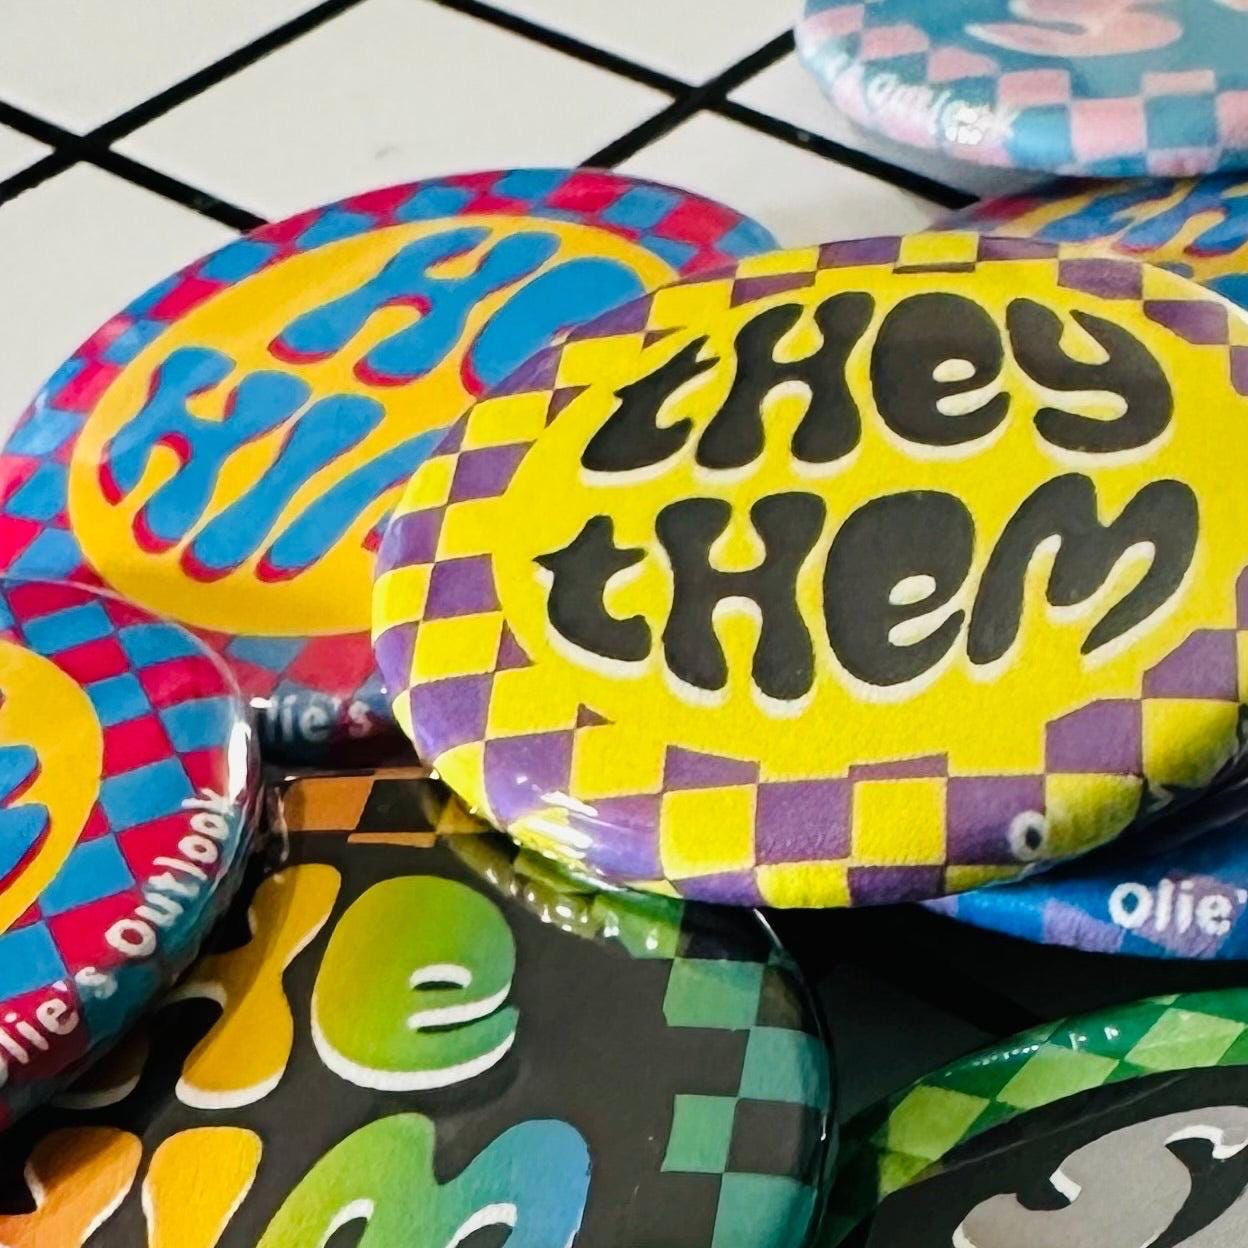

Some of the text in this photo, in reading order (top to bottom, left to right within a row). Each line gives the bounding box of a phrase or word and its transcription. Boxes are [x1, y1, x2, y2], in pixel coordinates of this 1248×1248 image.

[262, 693, 376, 742] lie's
[0, 787, 237, 1085] lie's Outlook
